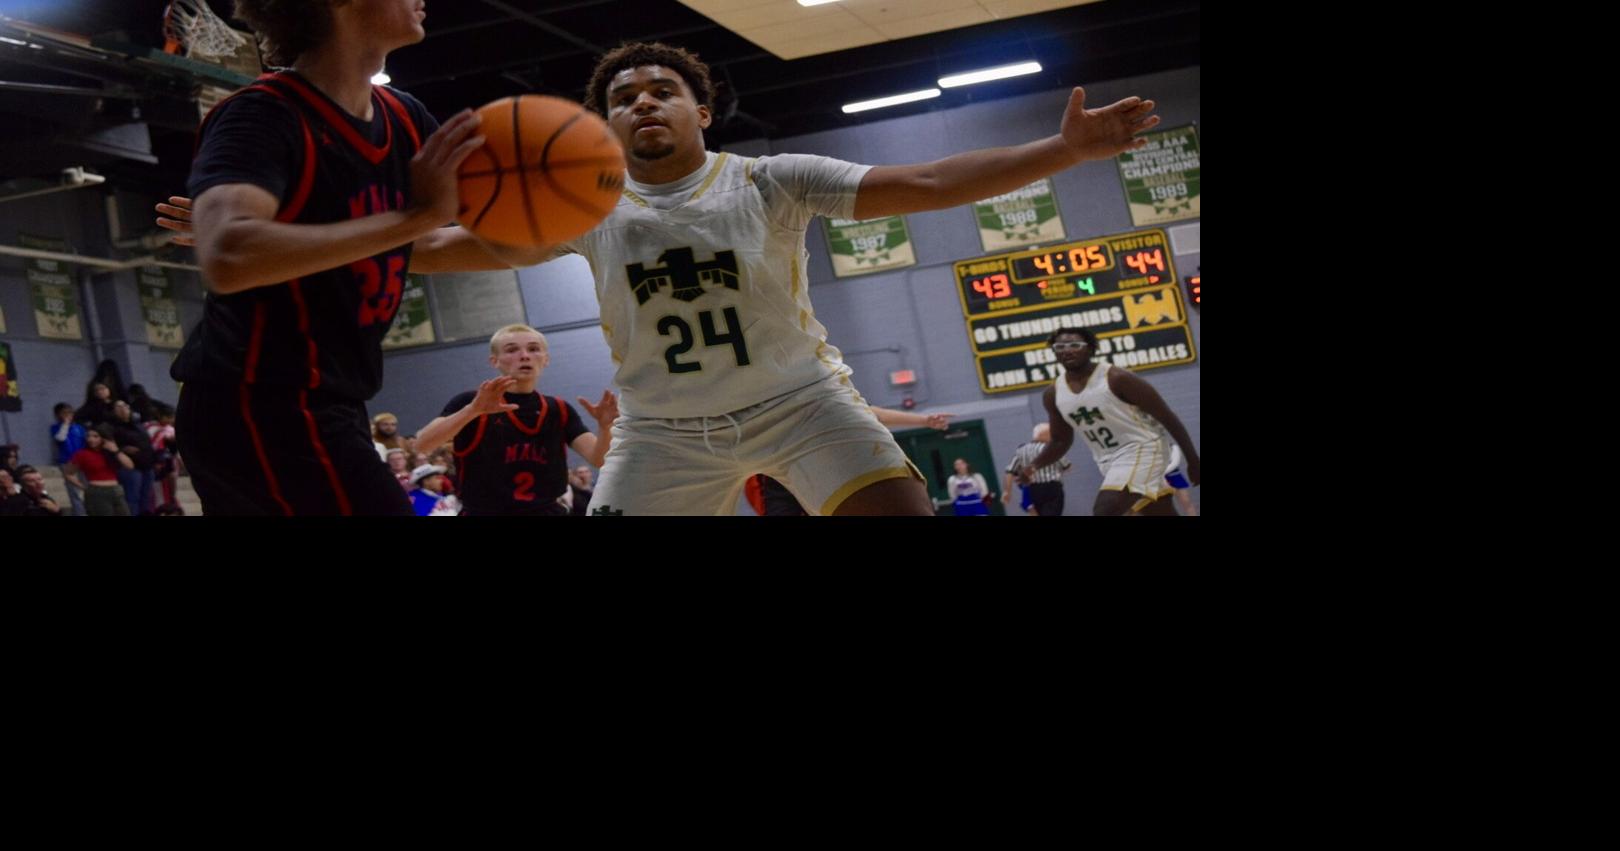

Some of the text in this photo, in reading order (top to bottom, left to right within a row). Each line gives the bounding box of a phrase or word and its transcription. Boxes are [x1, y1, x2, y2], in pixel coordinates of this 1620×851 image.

[1124, 160, 1200, 179] CHAMPIONS
[1149, 182, 1188, 200] 1989
[999, 208, 1038, 226] 1988
[850, 233, 887, 251] 1987
[1112, 235, 1162, 252] VISITOR
[1033, 246, 1107, 275] 4:05
[1126, 249, 1165, 275] 44
[972, 274, 1012, 299] 43
[1077, 276, 1095, 295] 4
[974, 306, 1123, 345] GO THUNDERBIRDS
[657, 306, 751, 374] 24
[1112, 335, 1136, 351] TO
[988, 369, 1027, 388] JOHN
[1030, 367, 1045, 381] &
[1112, 343, 1188, 368] MORALES
[1083, 426, 1120, 449] 42
[512, 471, 536, 501] 2
